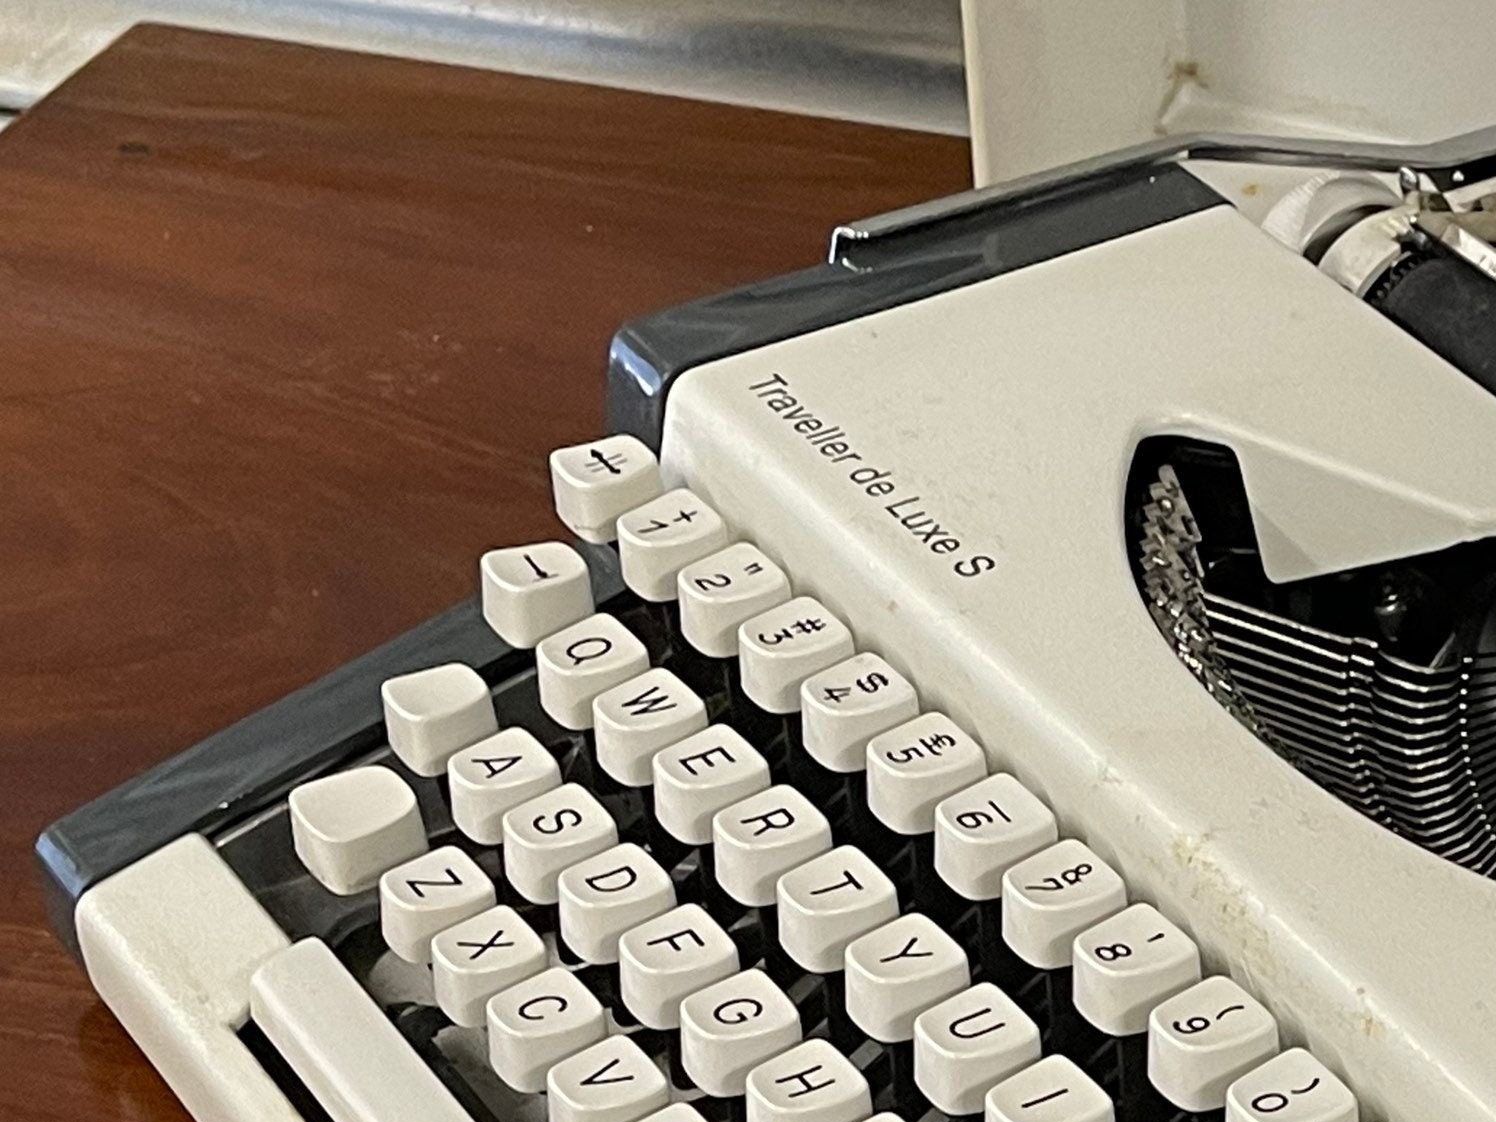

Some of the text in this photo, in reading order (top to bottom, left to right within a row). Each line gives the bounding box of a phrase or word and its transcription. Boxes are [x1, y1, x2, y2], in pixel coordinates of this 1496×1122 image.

[749, 373, 995, 577] Traveller de Luxe S
[638, 520, 669, 534] 1
[694, 573, 732, 592] 2
[757, 627, 795, 646] 3
[565, 637, 613, 666] Q
[621, 686, 678, 716] W
[824, 687, 851, 703] 4
[470, 755, 523, 779] A
[678, 746, 736, 776] E
[885, 746, 925, 764] 5
[532, 808, 583, 835] S
[740, 807, 795, 837] R
[955, 810, 994, 830] 6
[405, 868, 463, 898] Z
[584, 865, 637, 893] D
[809, 870, 864, 896] T
[1024, 877, 1065, 893] 7
[456, 929, 515, 961] X
[646, 928, 705, 952] F
[879, 937, 934, 964] Y
[1094, 943, 1133, 962] 8
[518, 995, 568, 1021] C
[712, 998, 763, 1025] G
[948, 1007, 1006, 1039] U
[1172, 1016, 1211, 1035] 9
[579, 1058, 635, 1087] V
[774, 1064, 836, 1098] H
[1021, 1088, 1069, 1109] I
[1251, 1092, 1289, 1113] 0
